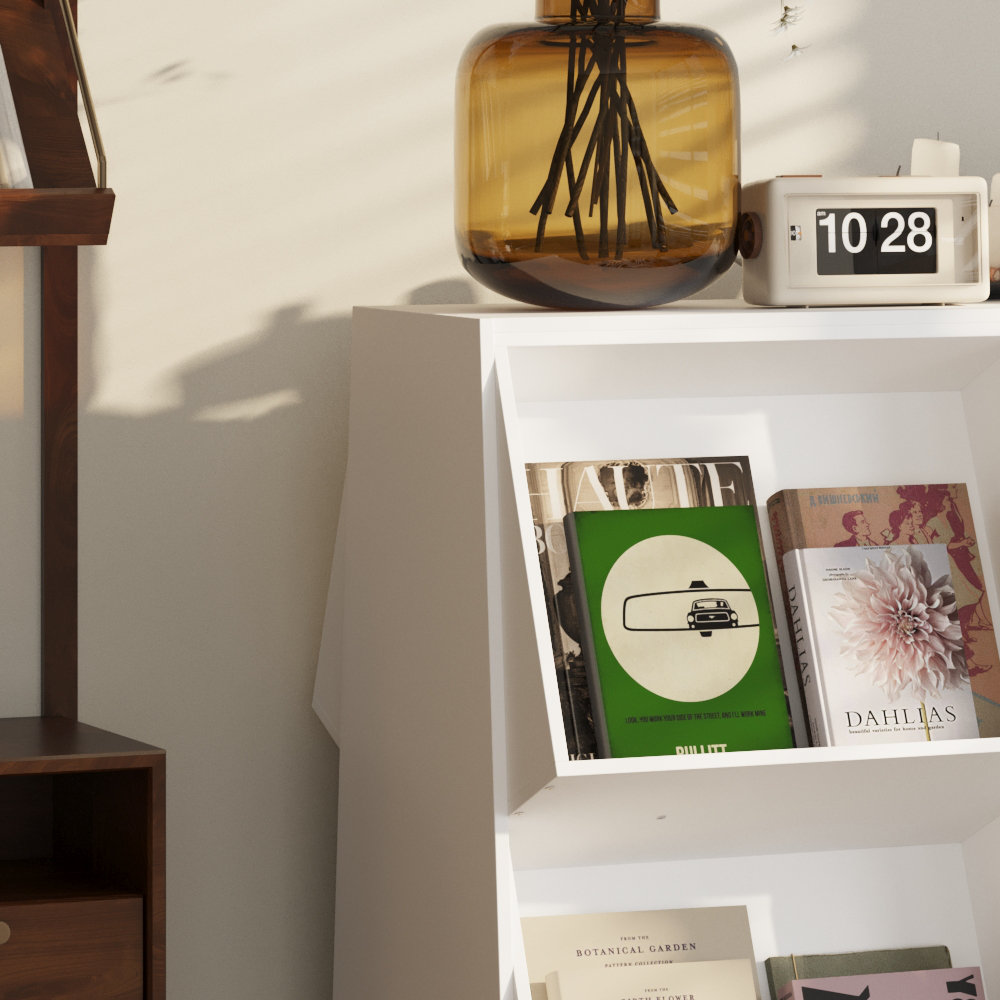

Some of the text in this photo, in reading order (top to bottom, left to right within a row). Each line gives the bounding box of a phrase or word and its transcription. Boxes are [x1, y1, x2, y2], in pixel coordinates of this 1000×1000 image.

[819, 211, 933, 254] 10 28
[788, 584, 811, 687] DAHLIAS
[845, 705, 957, 727] DAHLIAS
[576, 942, 697, 957] BOTANICAL GARDEN
